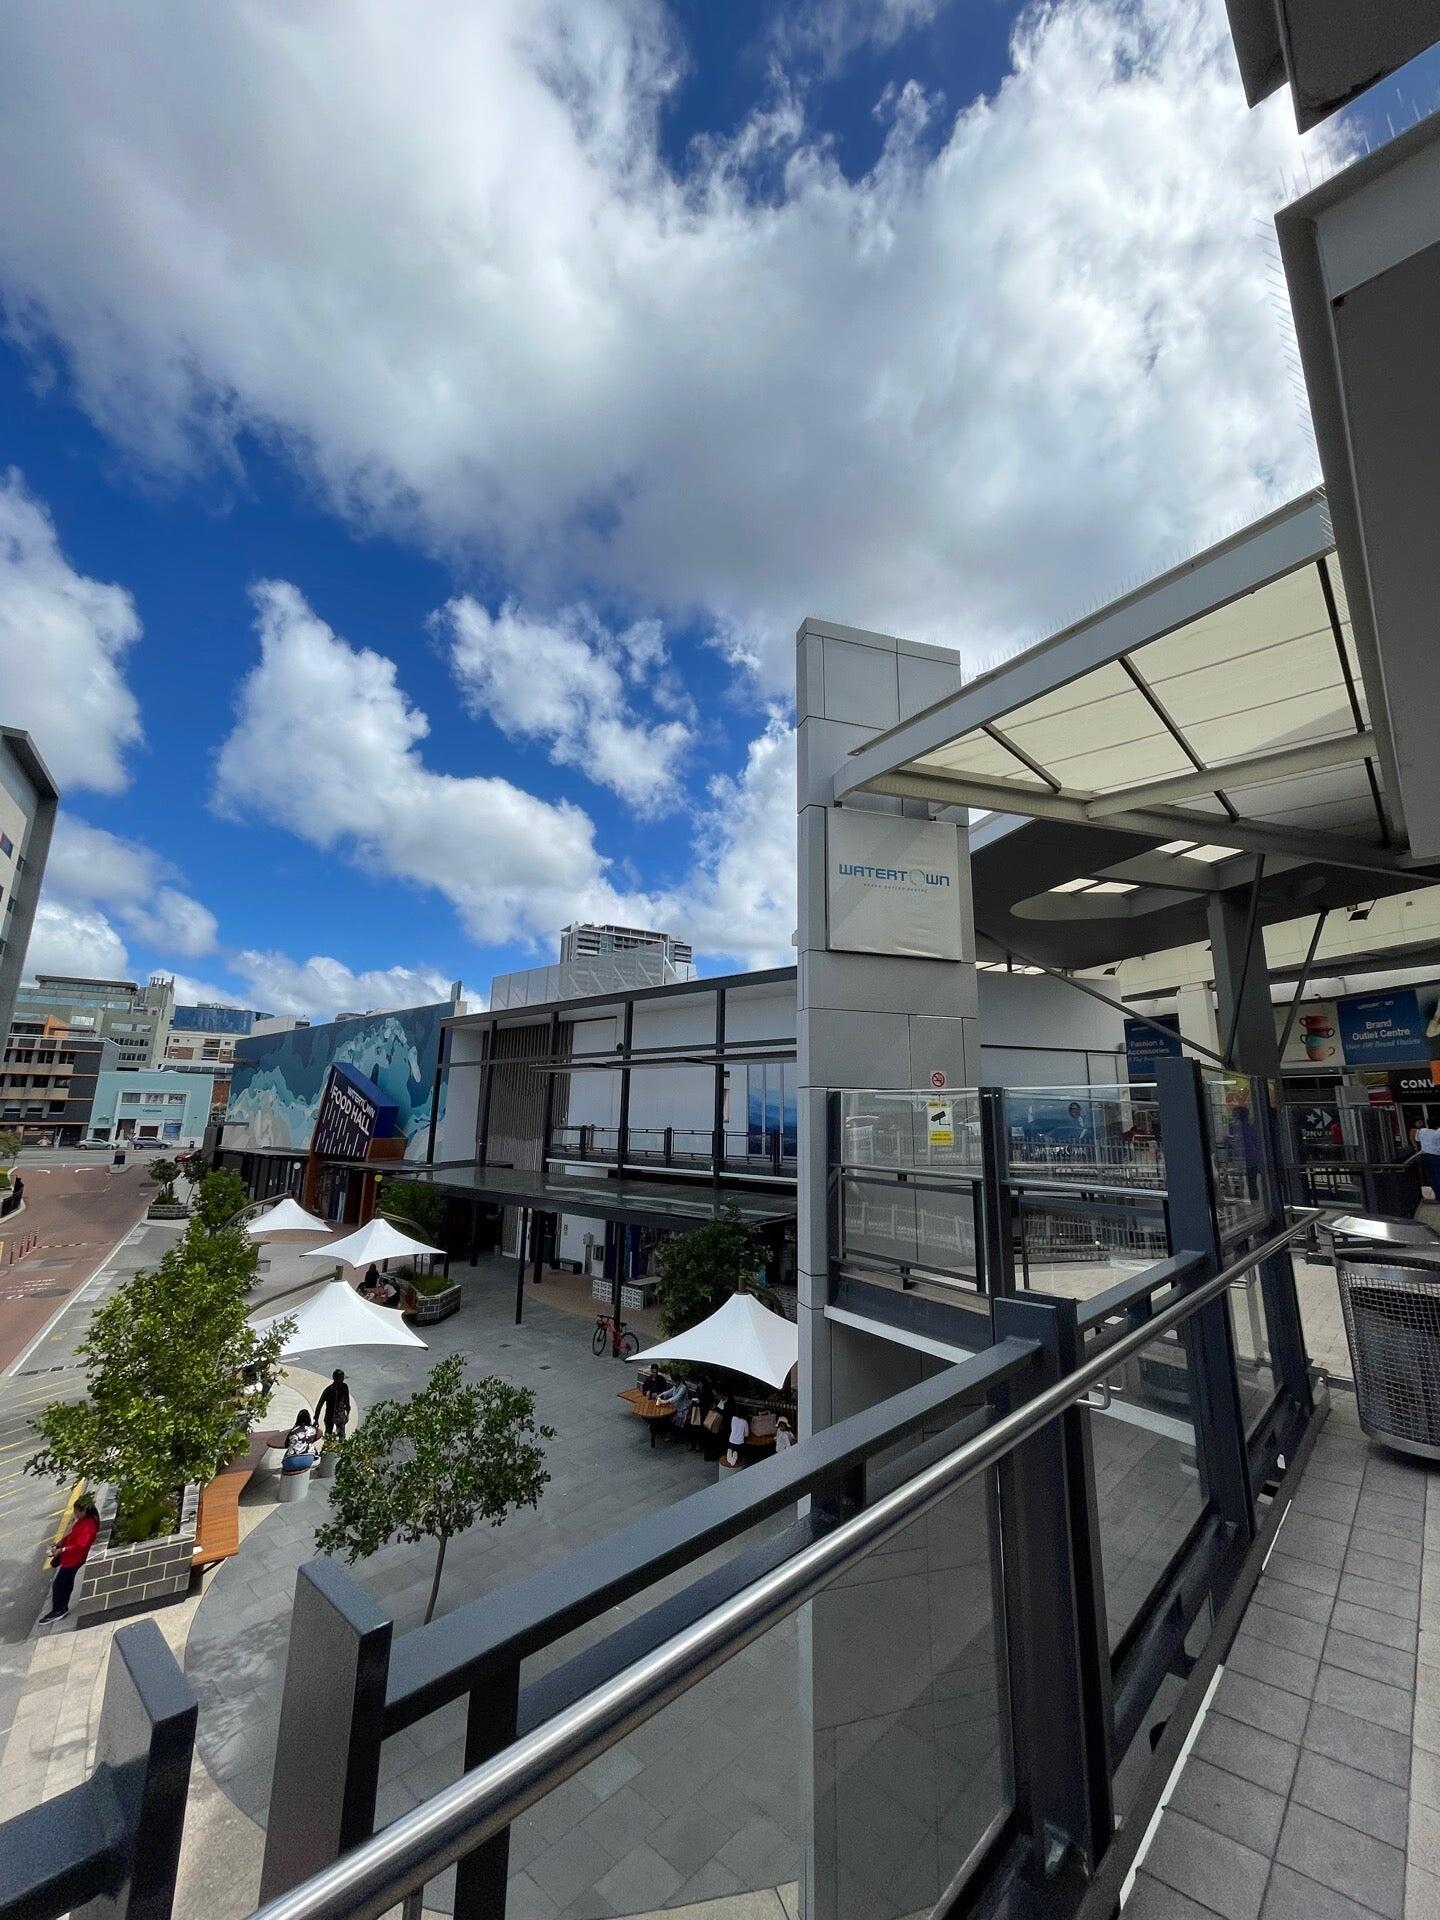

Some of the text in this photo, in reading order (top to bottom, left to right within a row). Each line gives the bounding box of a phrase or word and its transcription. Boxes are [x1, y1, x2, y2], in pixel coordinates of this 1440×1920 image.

[838, 863, 951, 887] WATERTOWN
[1365, 1019, 1393, 1030] Brand
[1352, 1028, 1411, 1041] Outlet Centre
[331, 1086, 370, 1136] FOOD HALL
